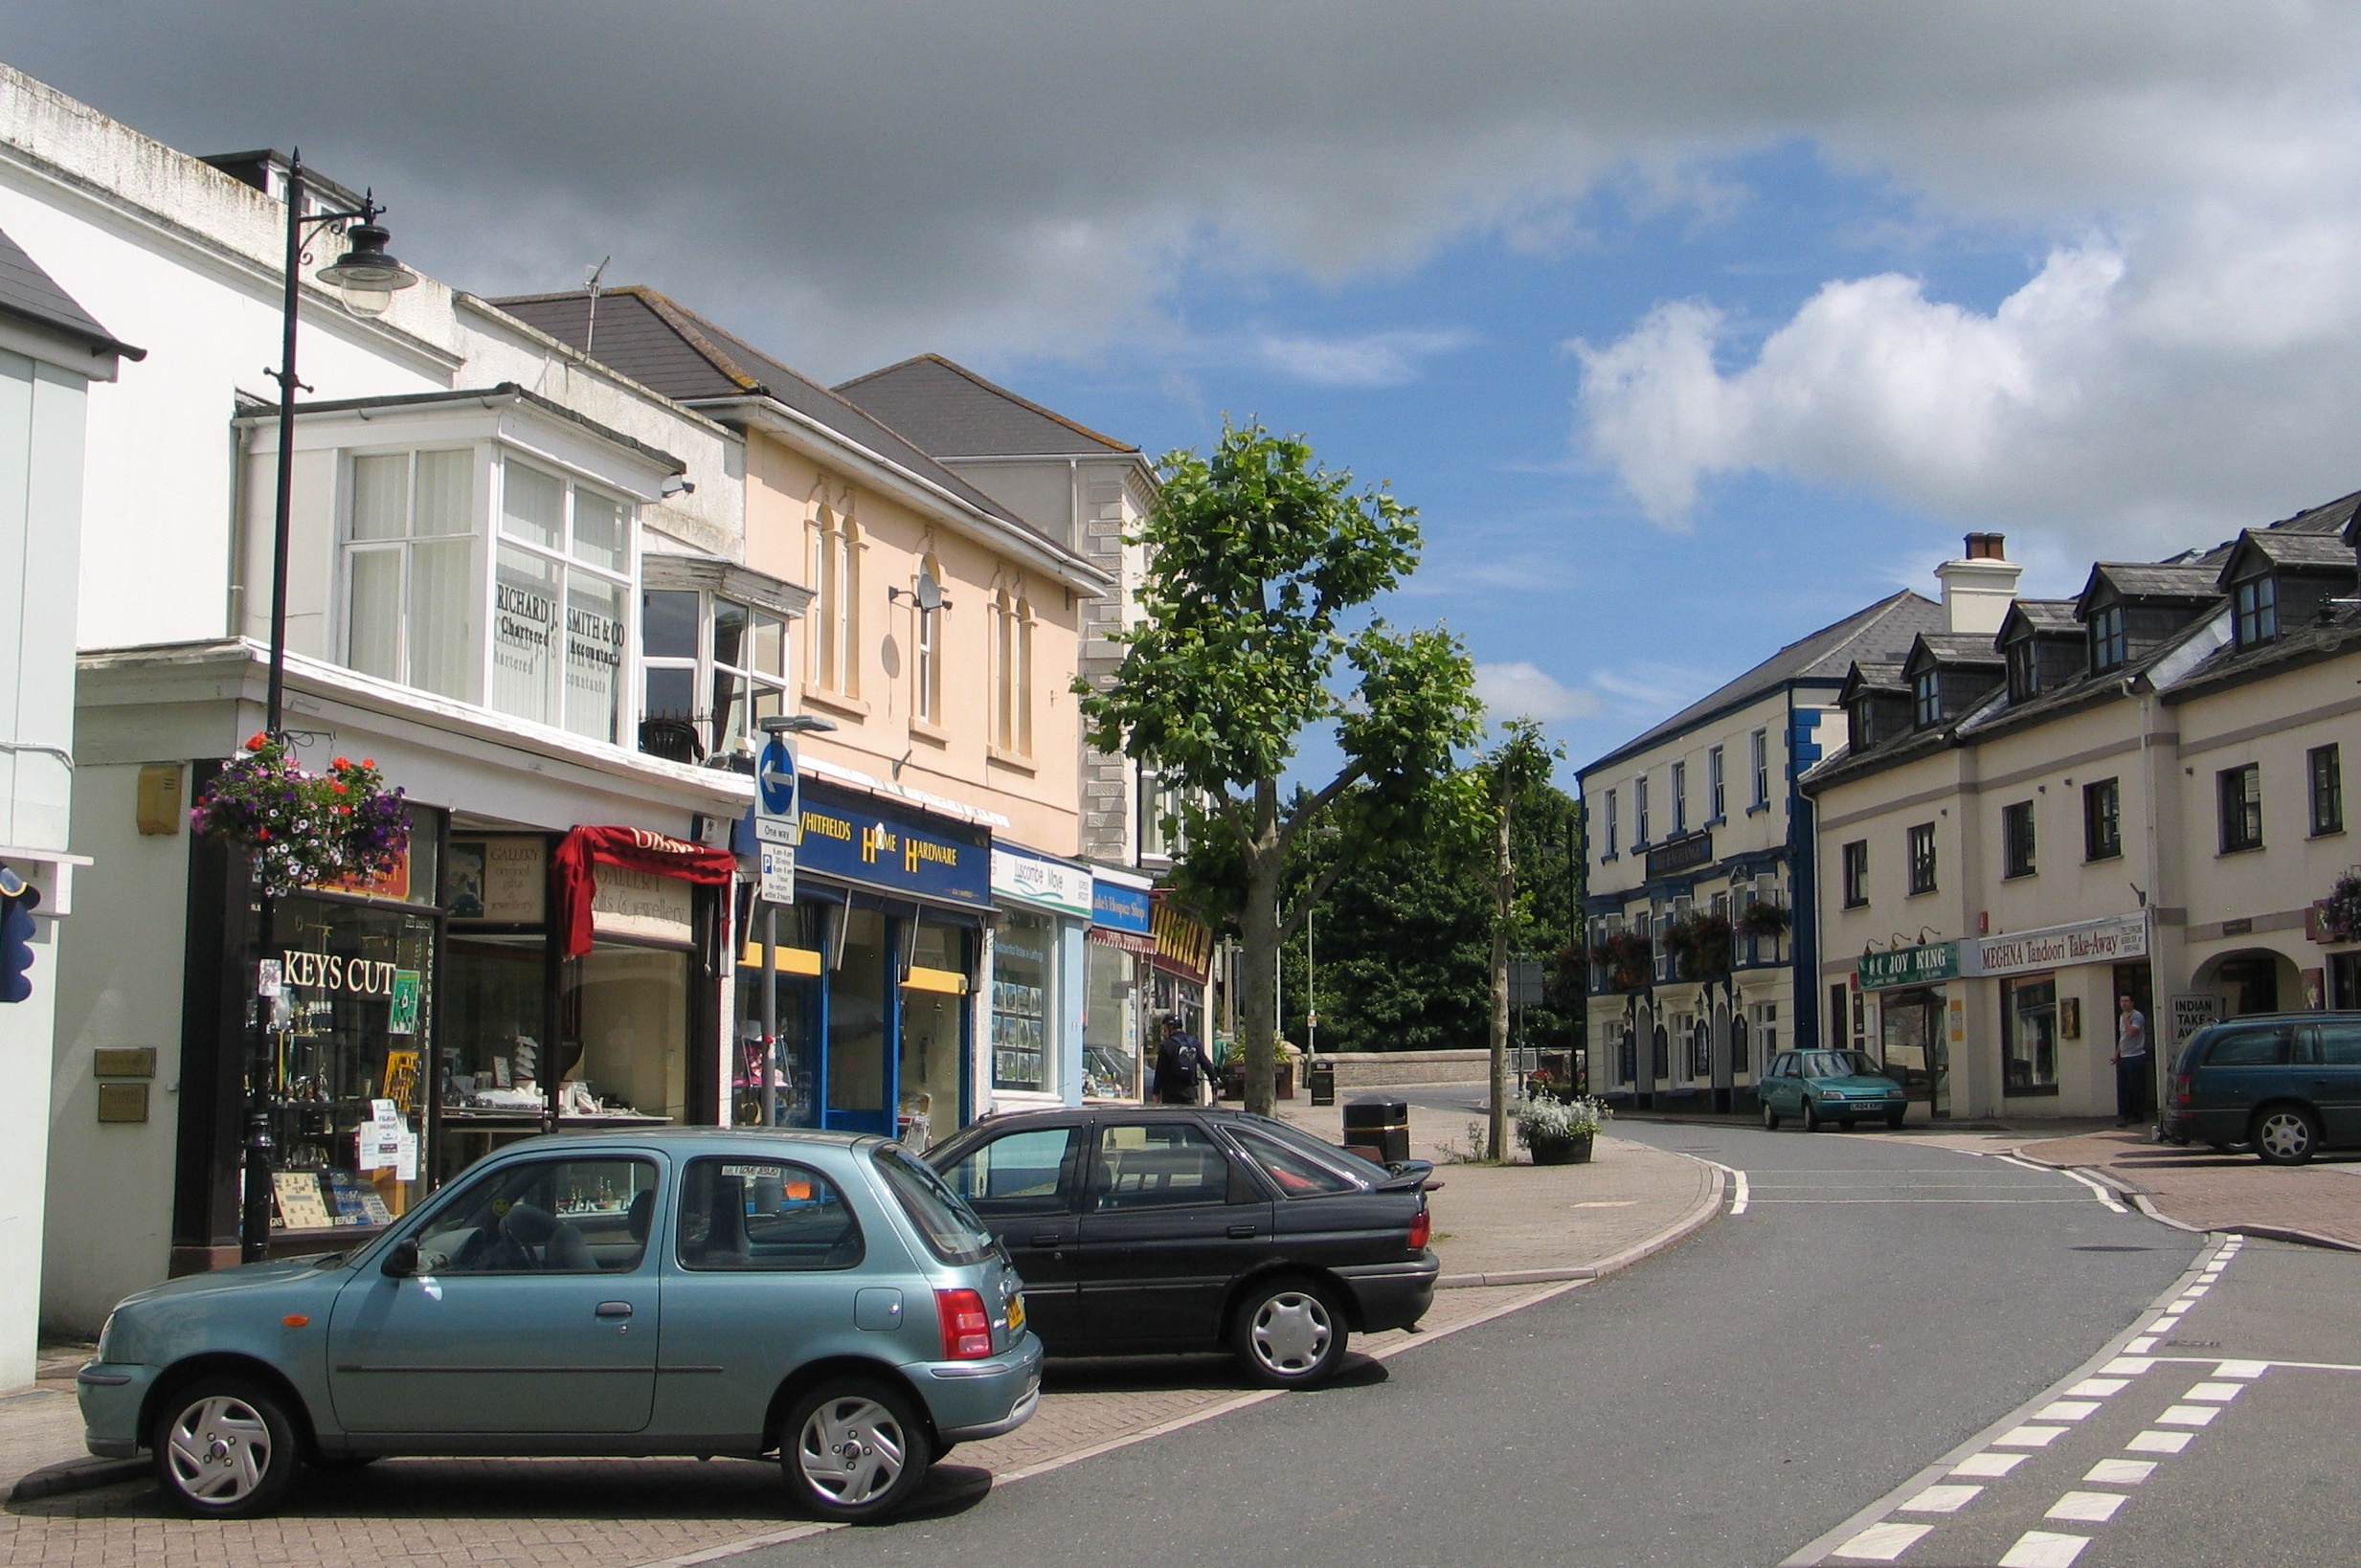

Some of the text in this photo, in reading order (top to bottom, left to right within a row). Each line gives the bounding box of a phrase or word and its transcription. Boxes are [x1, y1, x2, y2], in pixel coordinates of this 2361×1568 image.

[497, 584, 625, 648] RICHARD J. SMITH & CO
[501, 616, 550, 648] Chartered
[570, 637, 620, 668] Accountants
[765, 825, 790, 841] One way
[490, 847, 539, 862] GALLERY
[495, 865, 529, 878] original
[502, 878, 524, 891] gifts
[596, 864, 661, 892] GALLERY
[1014, 858, 1044, 885] Luscombe
[1047, 867, 1064, 894] Maye
[490, 900, 533, 914] jewellery
[632, 894, 686, 930] jewellery
[1109, 896, 1130, 919] Hospice
[1131, 901, 1146, 924] Shop
[1888, 952, 1909, 974] JOY
[1916, 948, 1945, 970] KING
[1982, 930, 2119, 970] MEGHNA Tandoori Take-Away
[282, 950, 396, 995] KEYS CUT
[425, 936, 434, 1050] LOCKSMITHS
[2175, 999, 2213, 1012] INDIAN
[2177, 1027, 2196, 1039] AW
